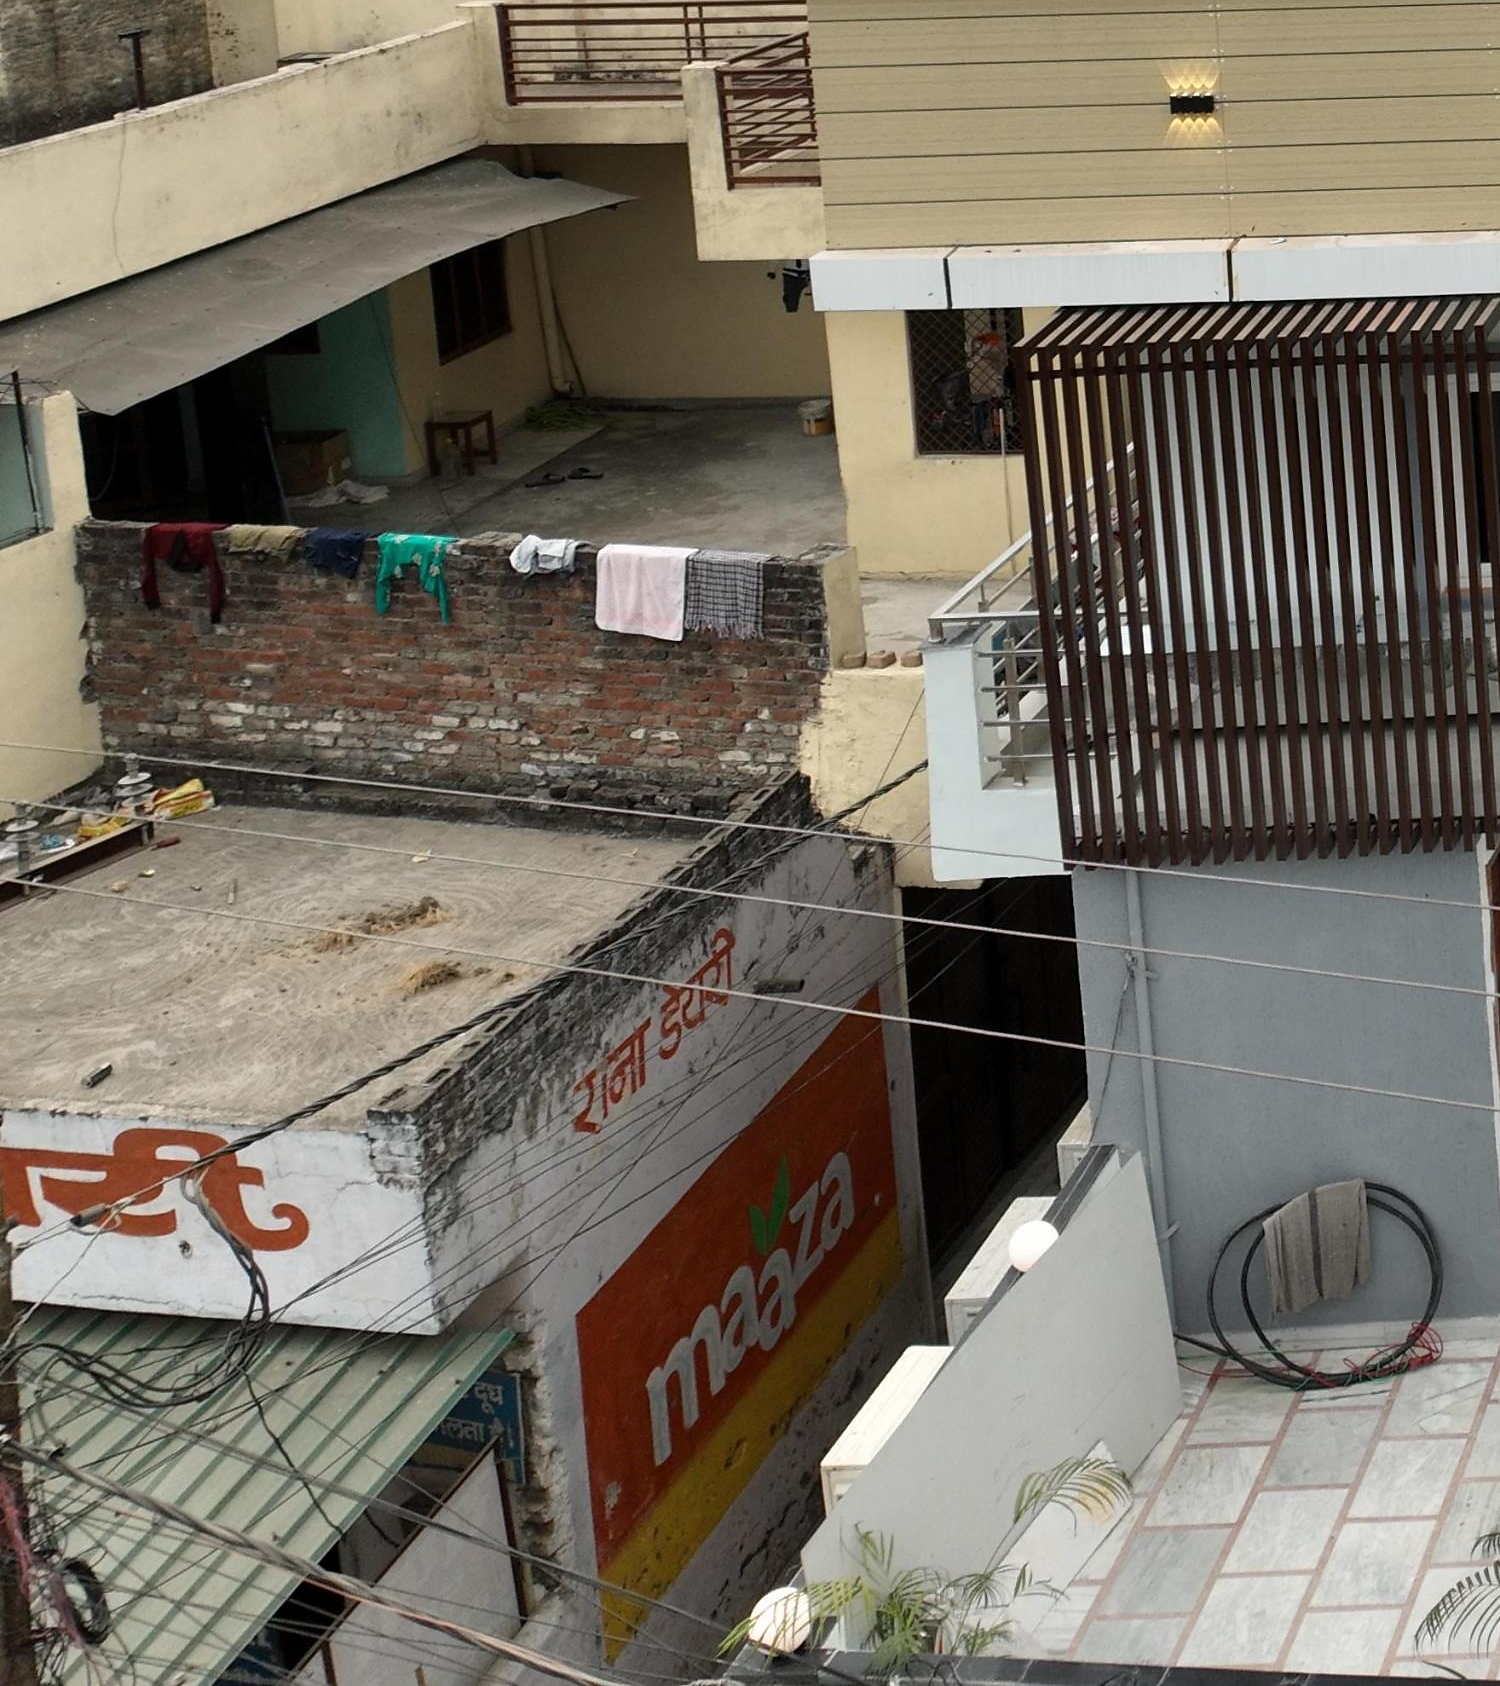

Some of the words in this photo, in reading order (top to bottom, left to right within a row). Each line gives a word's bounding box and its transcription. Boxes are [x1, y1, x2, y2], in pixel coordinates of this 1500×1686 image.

[573, 1016, 653, 1136] राना
[645, 1151, 856, 1468] maaza
[474, 1381, 504, 1416] दूध
